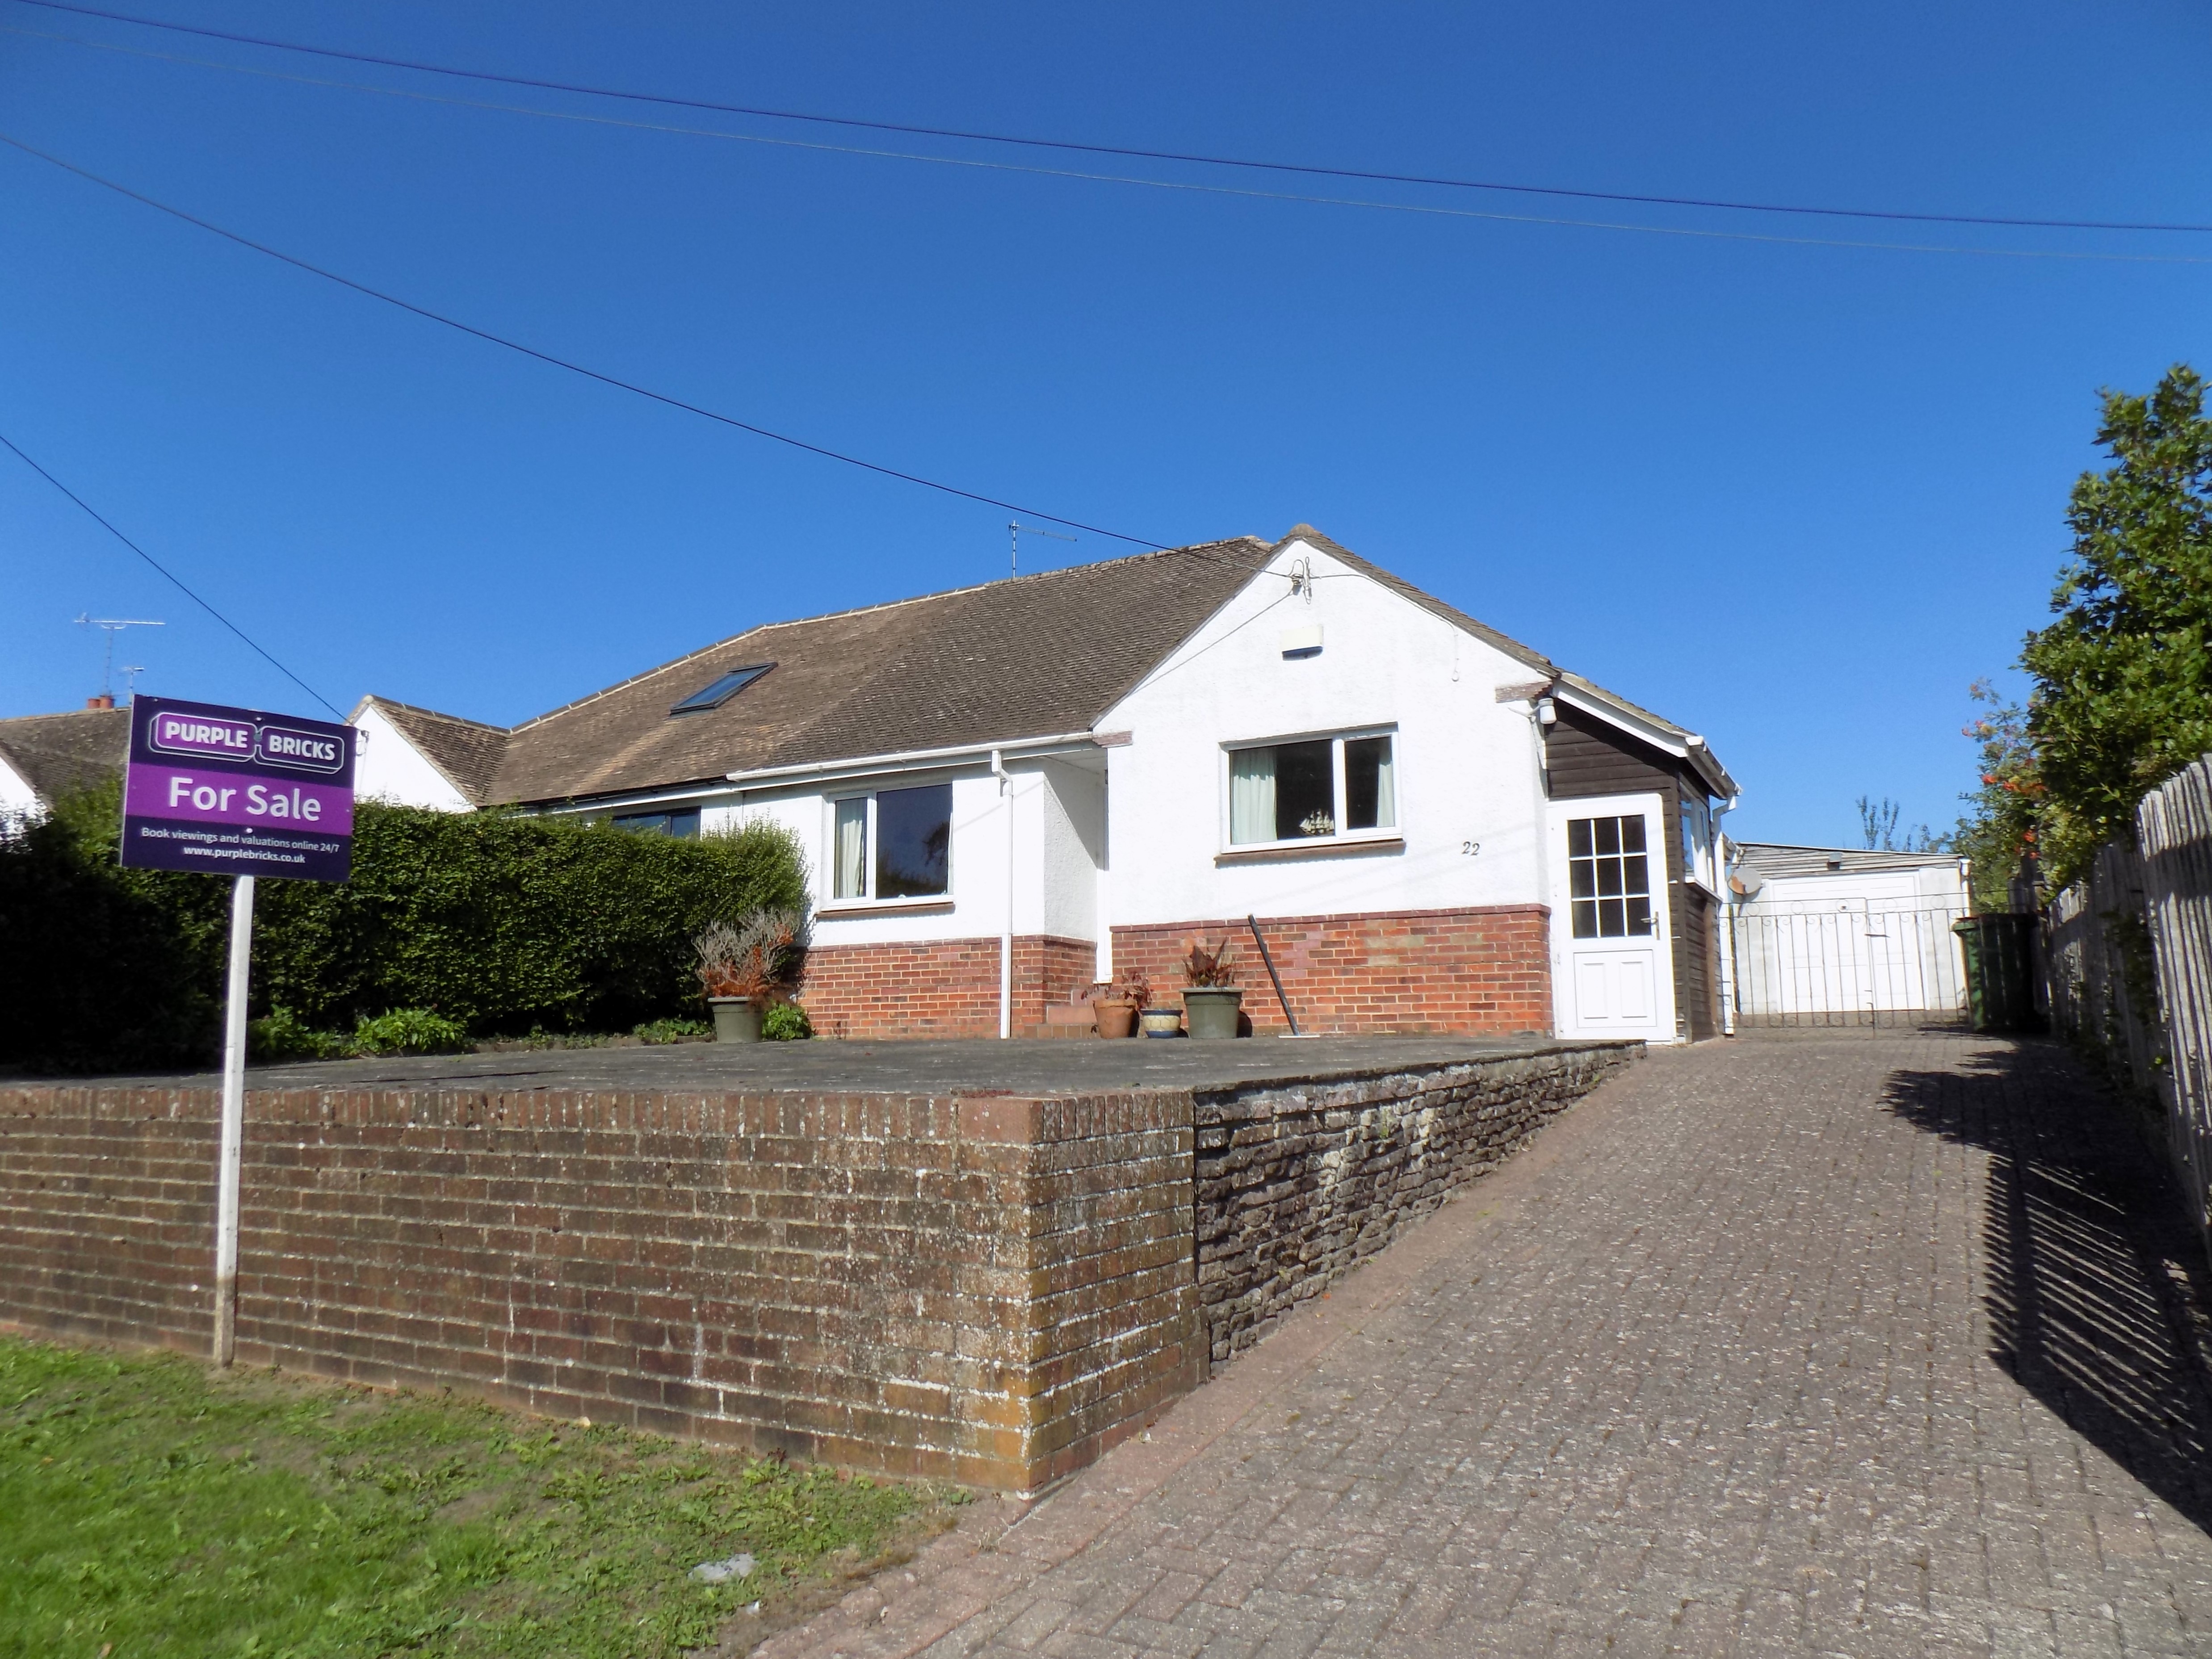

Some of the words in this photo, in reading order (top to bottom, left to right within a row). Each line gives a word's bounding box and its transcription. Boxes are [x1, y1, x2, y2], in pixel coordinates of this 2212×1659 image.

[165, 721, 248, 748] PURPLE
[269, 735, 336, 760] BRICKS
[170, 777, 236, 812] For
[246, 785, 321, 821] Sale
[142, 827, 169, 838] Book
[172, 830, 218, 843] viewings
[220, 834, 239, 843] and
[241, 835, 290, 848] valuations
[291, 840, 319, 851] online
[320, 843, 340, 853] 24/7
[1461, 841, 1480, 856] 22
[184, 846, 306, 863] www.purplebricks.co.uk
